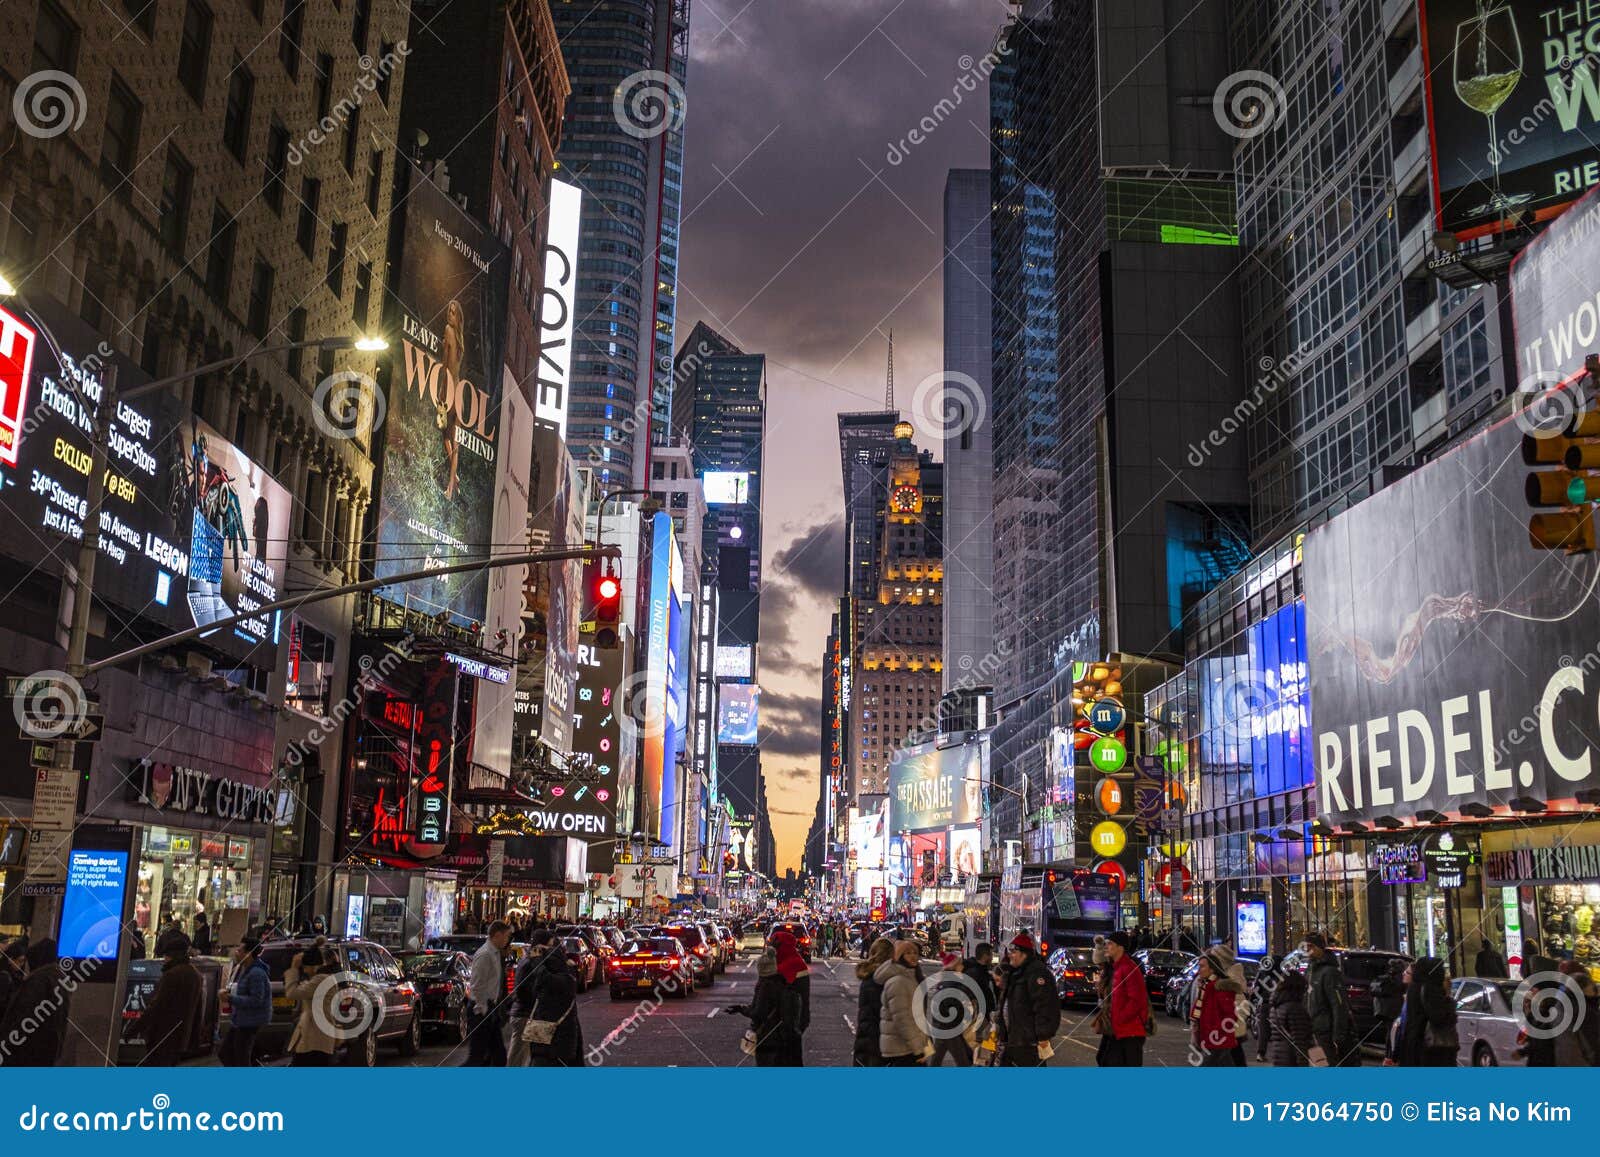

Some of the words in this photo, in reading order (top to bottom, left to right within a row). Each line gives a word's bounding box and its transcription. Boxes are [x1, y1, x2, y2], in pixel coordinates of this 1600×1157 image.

[1543, 28, 1600, 71] DEC
[1554, 160, 1600, 195] RIE
[1570, 202, 1600, 247] WIN
[435, 219, 453, 248] Keep
[453, 234, 472, 261] 2019
[472, 249, 490, 274] Kind
[402, 314, 439, 353] LEAVE
[536, 244, 571, 432] COVE
[1525, 337, 1543, 380] IT
[1548, 291, 1600, 368] WO
[402, 338, 496, 442] WOOL
[41, 376, 77, 427] Photo,
[107, 424, 156, 476] SuperStore
[116, 400, 152, 441] Largest
[455, 426, 494, 462] BEHIND
[118, 480, 136, 504] B&H
[31, 470, 51, 496] 34th
[50, 480, 80, 516] Street
[78, 499, 88, 520] @
[111, 515, 142, 552] Avenue,
[43, 505, 60, 531] Just
[60, 515, 68, 533] A
[104, 540, 126, 565] Away
[407, 517, 429, 536] ALICIA
[429, 527, 470, 554] SILVERSTONE
[145, 532, 188, 577] LEGION
[252, 576, 276, 602] OUTSIDE
[265, 565, 275, 582] ON
[248, 622, 268, 639] INSIDE
[652, 599, 663, 650] UNLOCK
[576, 643, 601, 667] RL
[488, 666, 510, 684] PRIME
[33, 721, 57, 731] ONE
[1097, 708, 1112, 722] m
[1101, 748, 1117, 762] m
[1319, 666, 1600, 815] RIEDEL.C
[40, 770, 48, 782] 3
[216, 777, 276, 824] GIFTS
[906, 775, 953, 815] PASSAGE
[421, 796, 442, 842] BAR
[524, 809, 559, 831] OW
[562, 812, 606, 834] OPEN
[1100, 832, 1115, 845] m
[72, 865, 88, 873] Free,
[89, 866, 107, 874] super
[108, 865, 122, 873] fast,
[73, 858, 98, 867] Coming
[1516, 849, 1532, 880] ON
[1533, 847, 1555, 880] THE
[1556, 844, 1600, 880] SQUAR
[88, 880, 103, 888] right
